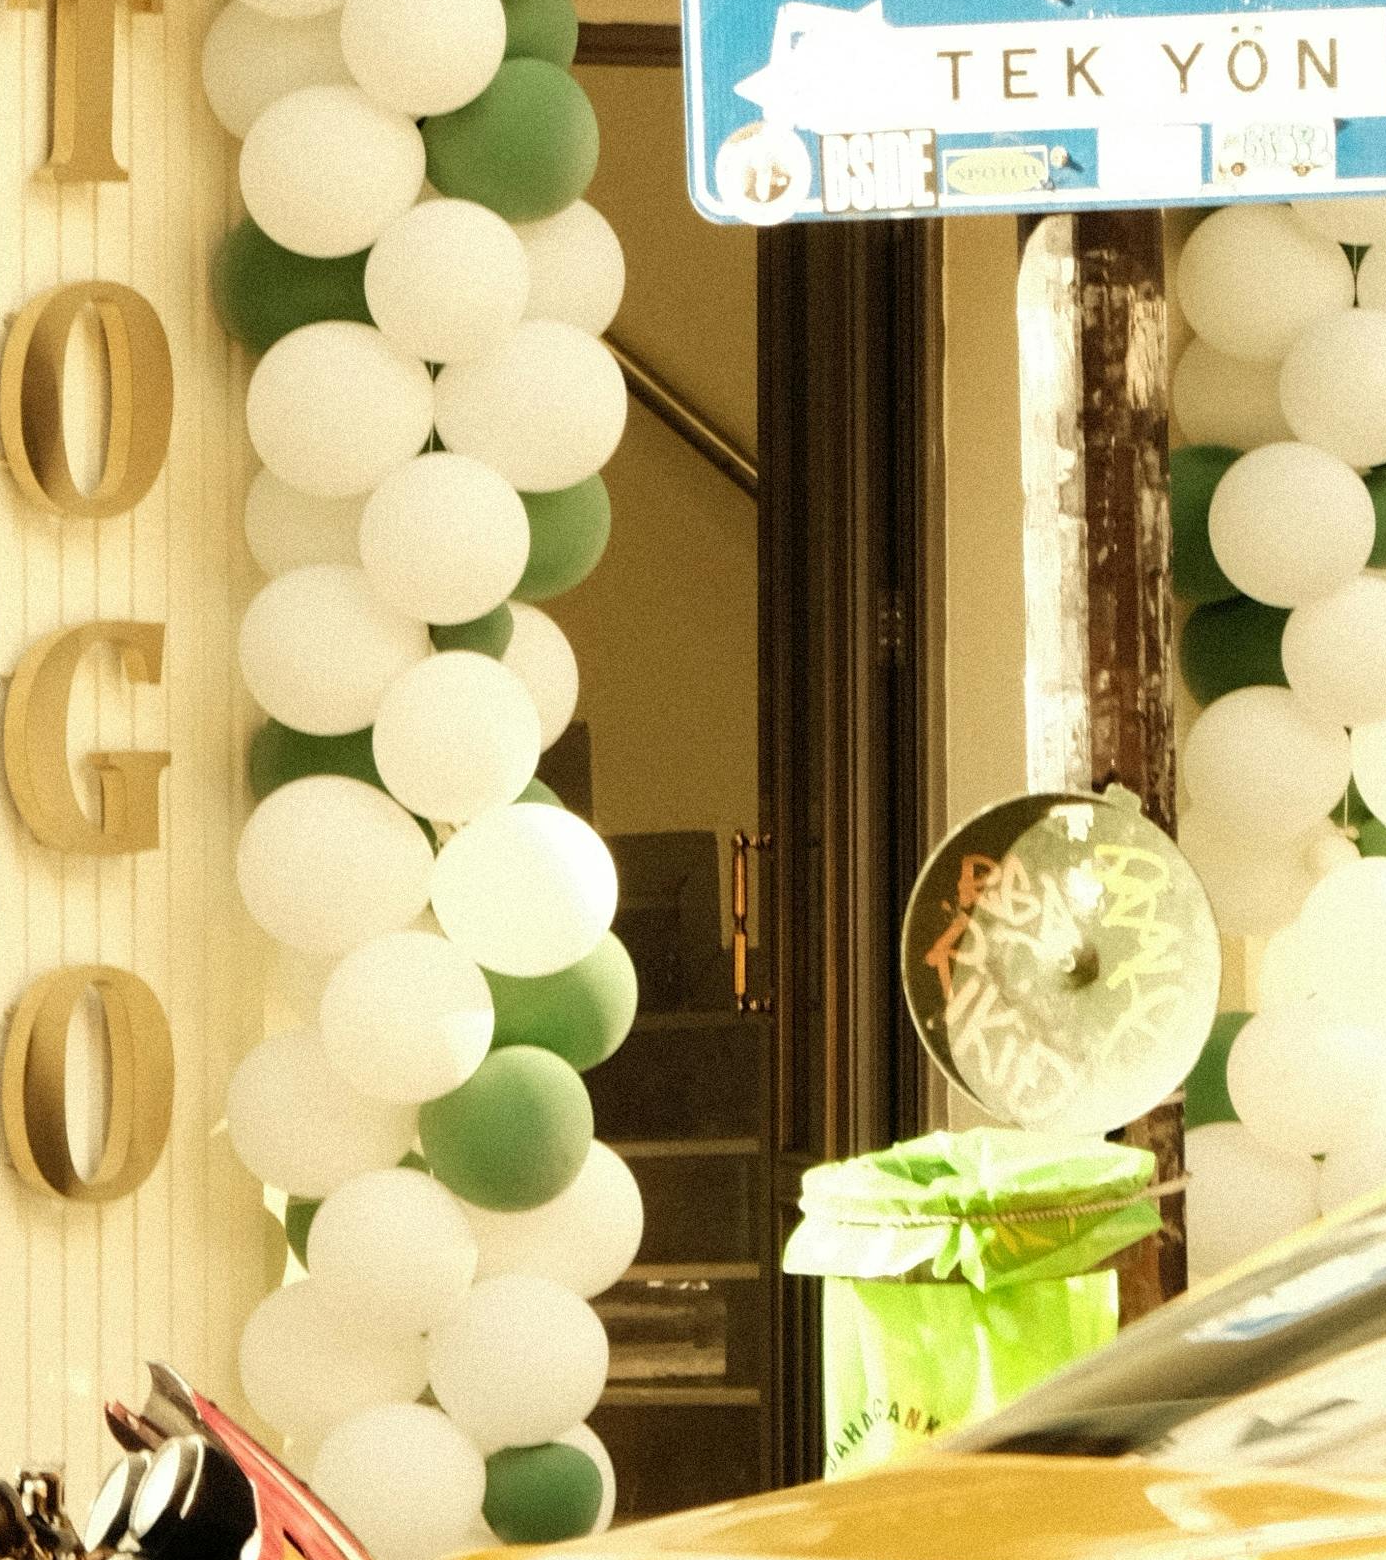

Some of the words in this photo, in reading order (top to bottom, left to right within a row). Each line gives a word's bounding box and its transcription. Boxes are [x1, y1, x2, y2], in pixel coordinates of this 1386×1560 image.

[937, 46, 1104, 100] TEK
[1162, 26, 1338, 94] YÖN
[824, 129, 936, 213] BSIDE
